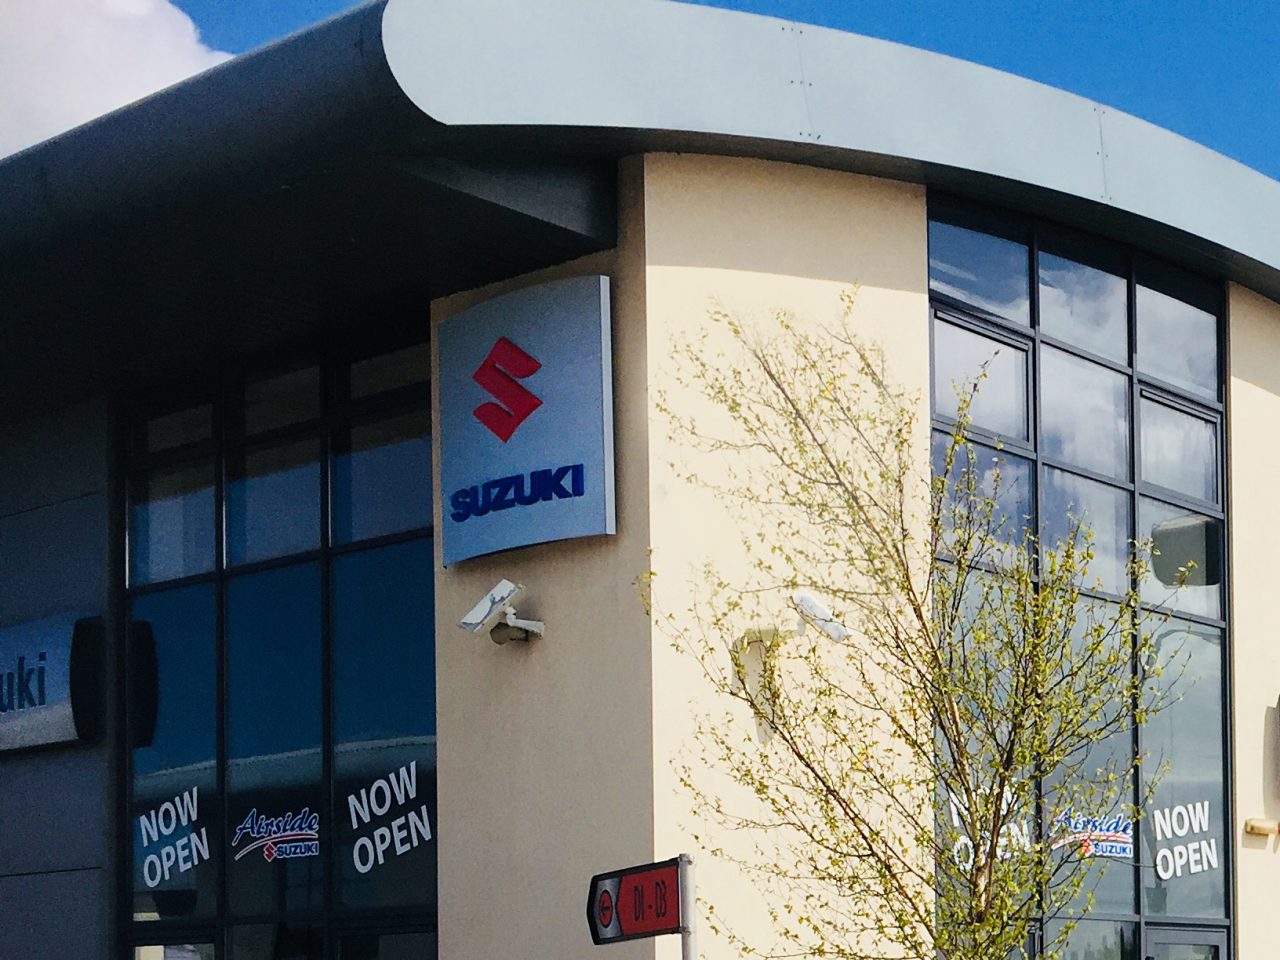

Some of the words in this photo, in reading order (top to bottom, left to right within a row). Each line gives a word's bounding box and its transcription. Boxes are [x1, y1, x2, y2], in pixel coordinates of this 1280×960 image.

[450, 463, 585, 522] SUZUKI
[348, 760, 418, 830] NOW
[139, 786, 199, 848] NOW
[232, 807, 320, 847] Airside
[1050, 806, 1134, 838] Airside
[1153, 800, 1211, 842] NOW
[143, 827, 210, 888] OPEN
[276, 841, 320, 858] SUZUKI
[353, 804, 433, 875] OPEN
[1092, 842, 1133, 856] SUZUKI
[1155, 838, 1219, 881] OPEN
